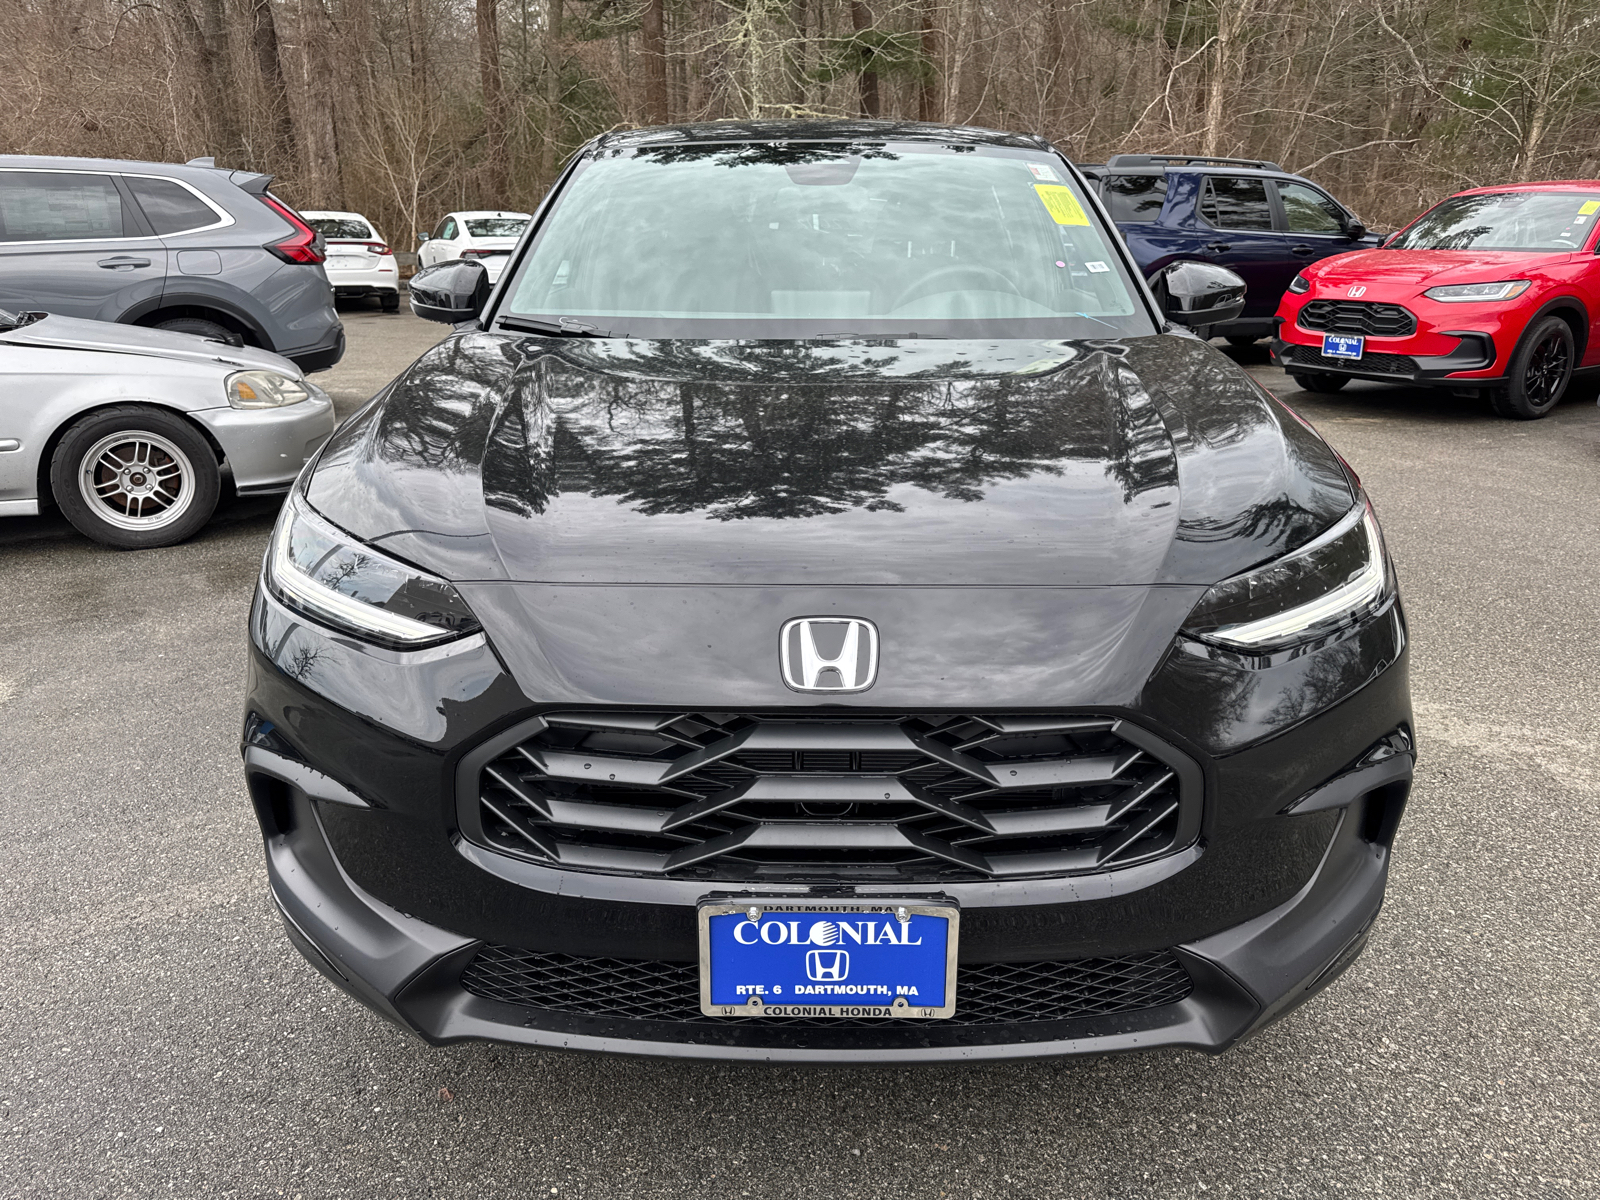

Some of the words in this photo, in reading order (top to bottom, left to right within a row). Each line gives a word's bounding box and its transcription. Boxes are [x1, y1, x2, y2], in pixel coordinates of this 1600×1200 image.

[870, 905, 894, 913] MA
[733, 920, 923, 947] COLONIAL
[736, 985, 769, 995] RTE.
[773, 985, 782, 995] 6
[794, 985, 892, 997] DARTMOUTH,
[896, 985, 919, 996] MA
[763, 1006, 836, 1017] COLONIAL
[840, 1007, 892, 1017] HONDA
